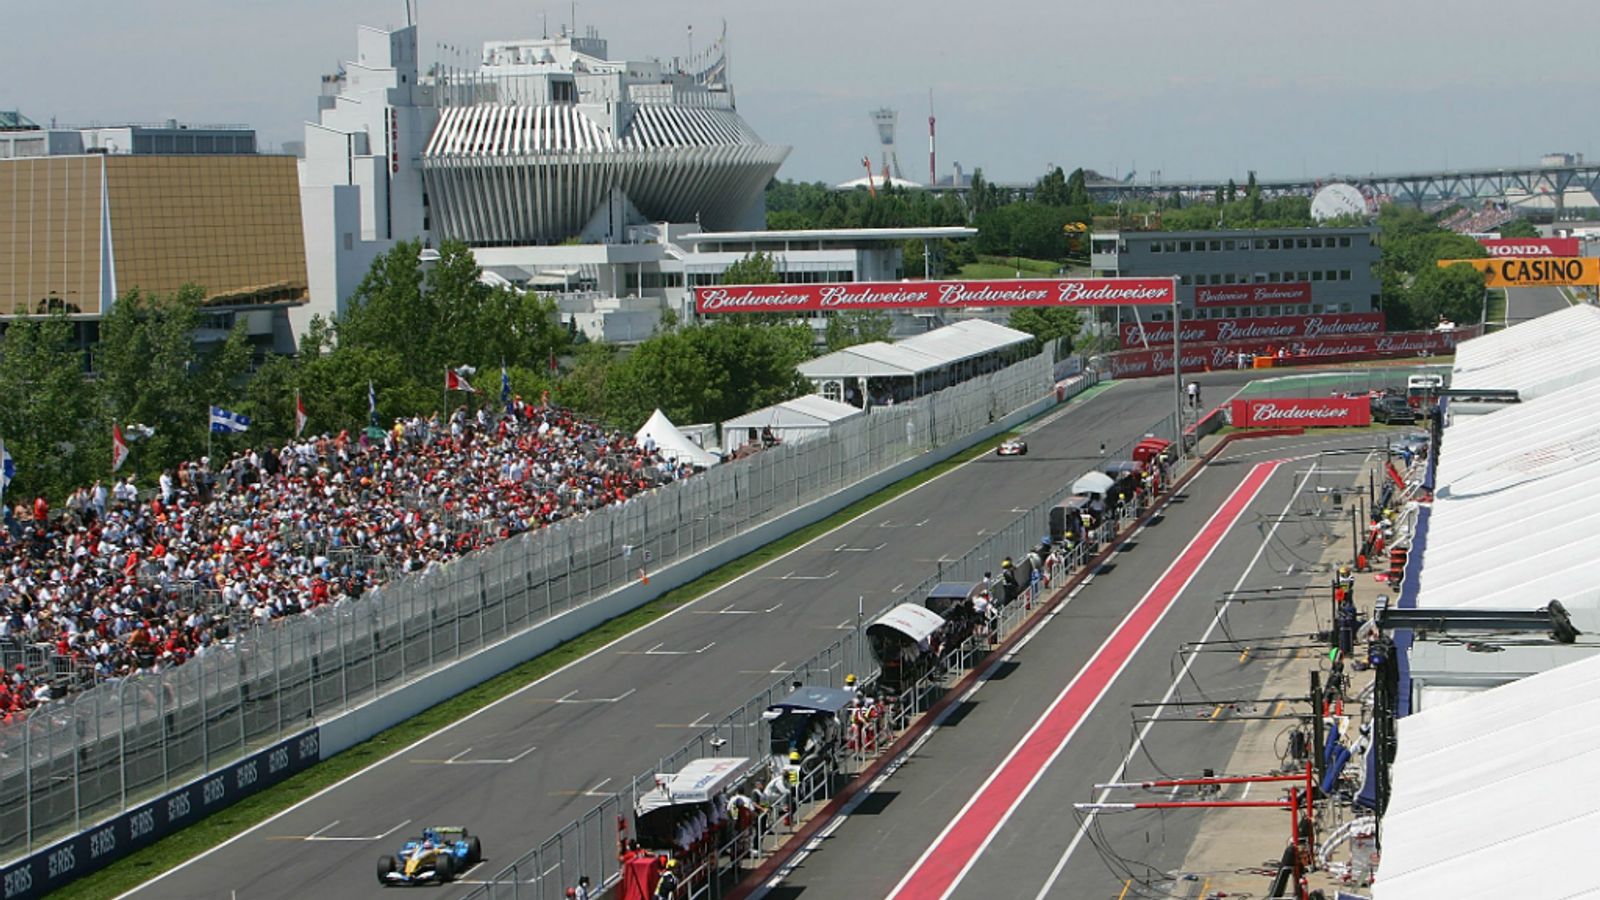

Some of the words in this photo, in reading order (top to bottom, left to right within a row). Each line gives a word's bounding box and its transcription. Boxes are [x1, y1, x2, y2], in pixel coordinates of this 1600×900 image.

[1486, 245, 1552, 255] HONDA
[1502, 260, 1583, 281] CASINO
[702, 289, 809, 309] Budweiser
[819, 286, 928, 306] Budweiser
[938, 283, 1048, 303] Budweiser
[1058, 282, 1168, 302] Budweiser
[1254, 288, 1304, 301] Budweiser
[1125, 325, 1206, 345] Budwiser
[1217, 321, 1296, 340] Budweiser
[1304, 318, 1379, 337] Budweiser
[1253, 403, 1348, 421] Budweiser
[14, 863, 32, 895] RBS
[57, 844, 76, 874] RBS
[99, 825, 116, 856] RBS
[139, 808, 154, 835] RBS
[175, 791, 191, 820] RBS
[211, 775, 225, 801] RBS
